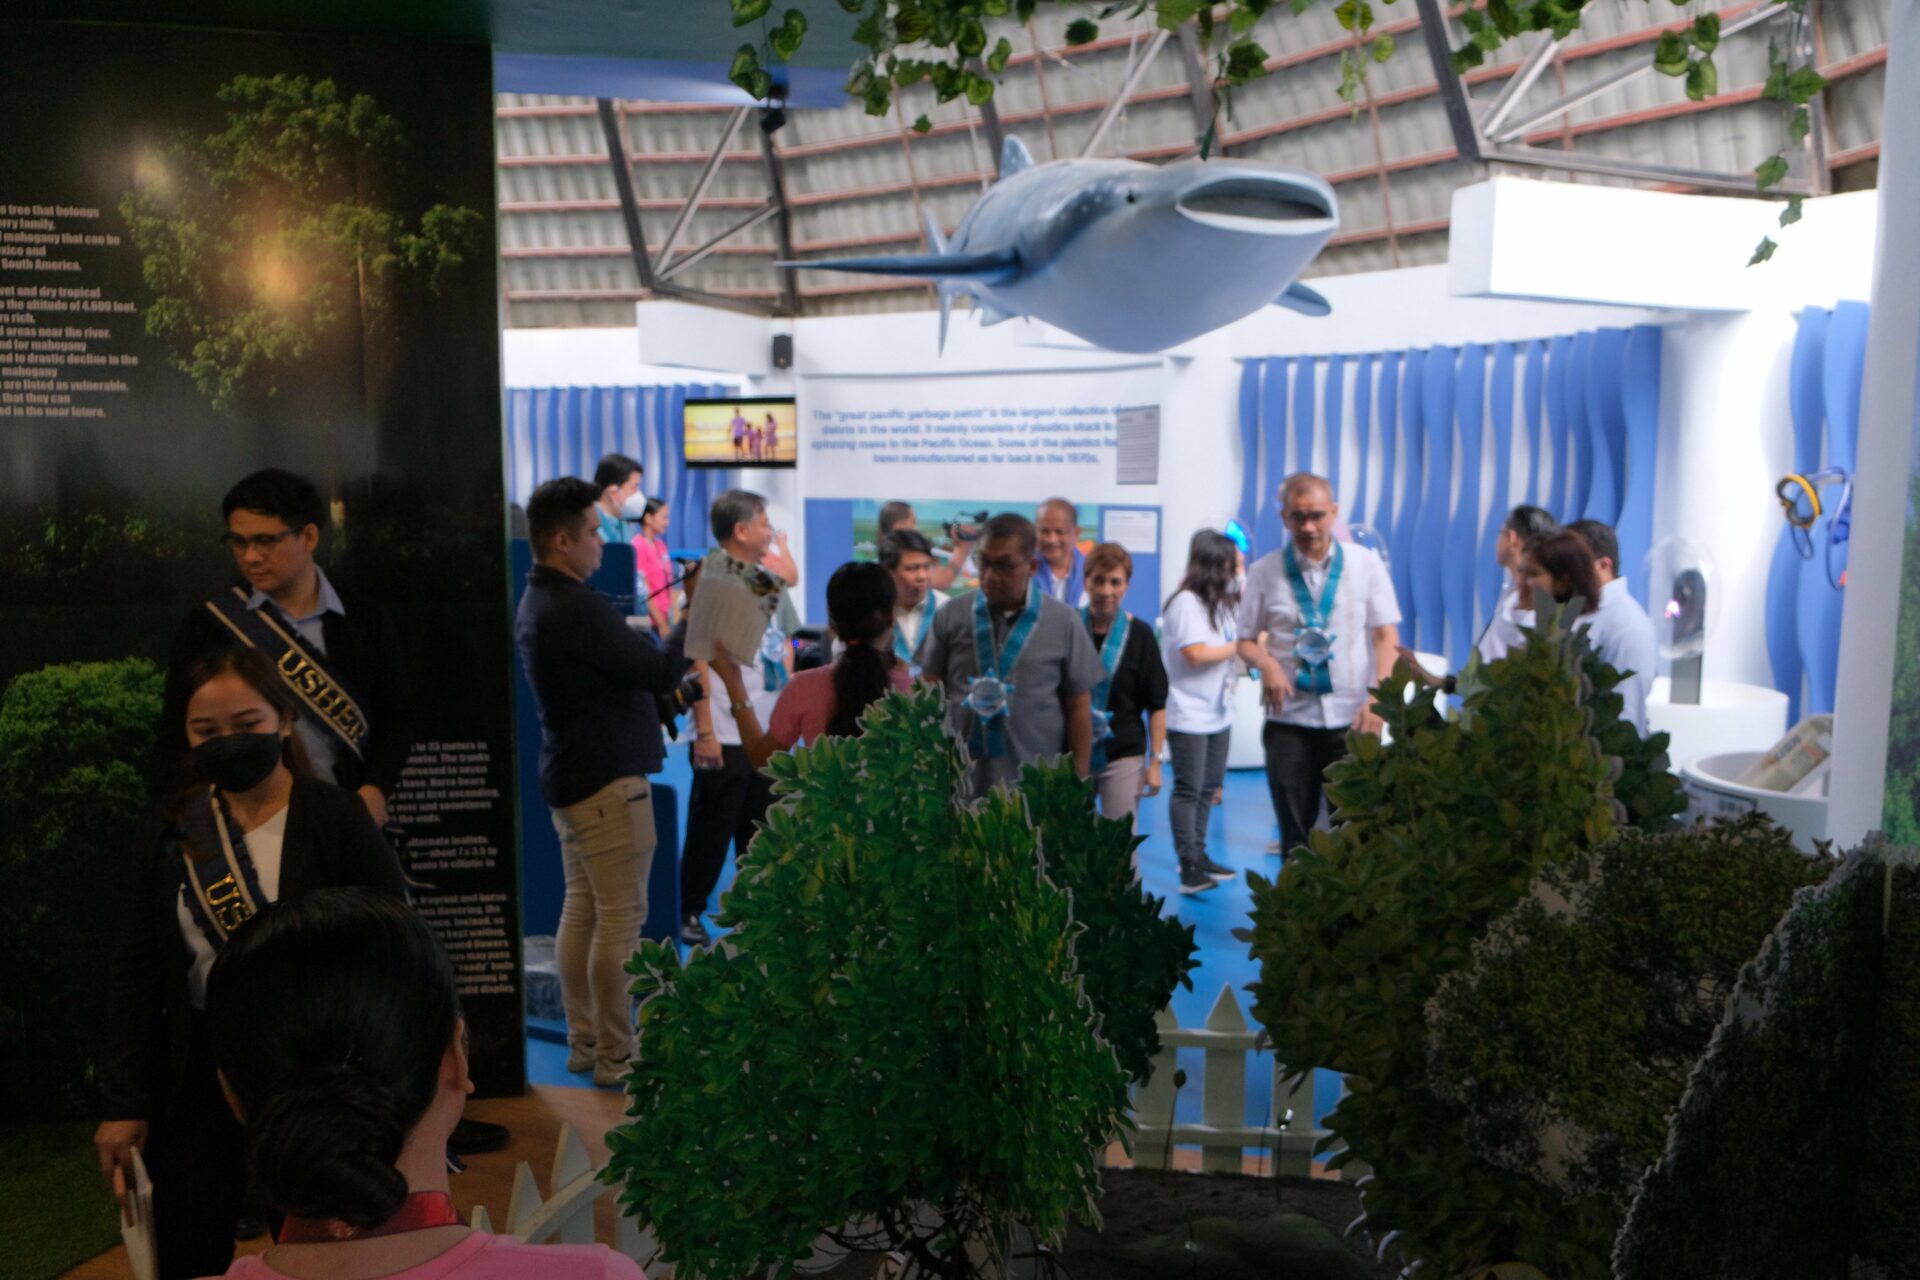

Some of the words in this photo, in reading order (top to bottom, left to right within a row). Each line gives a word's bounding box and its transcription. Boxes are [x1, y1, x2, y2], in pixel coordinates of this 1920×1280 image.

[8, 205, 31, 215] tree
[33, 205, 54, 216] that
[56, 205, 99, 218] belongs
[19, 219, 56, 230] family.
[4, 231, 60, 244] mahogany
[62, 234, 83, 244] that
[85, 236, 104, 245] can
[107, 234, 120, 245] be
[25, 246, 46, 256] and
[1, 258, 33, 269] South
[35, 259, 82, 271] America.
[17, 286, 37, 296] and
[39, 286, 56, 298] dry
[59, 287, 101, 299] tropical
[6, 300, 24, 310] the
[26, 300, 67, 311] altitude
[69, 301, 80, 312] of
[113, 303, 137, 314] feet.
[11, 313, 35, 324] rich.
[7, 327, 36, 336] areas
[39, 328, 62, 337] near
[65, 327, 82, 337] the
[84, 328, 110, 338] river.
[14, 340, 28, 349] for
[31, 341, 87, 352] mahogany
[15, 354, 25, 363] to
[28, 354, 65, 363] drastic
[67, 354, 107, 364] decline
[109, 355, 119, 365] in
[121, 354, 138, 365] the
[2, 367, 57, 378] mahogany
[4, 381, 21, 390] are
[23, 380, 53, 390] listed
[56, 381, 68, 390] as
[70, 380, 128, 392] vulnerable.
[2, 393, 23, 403] that
[25, 393, 49, 405] they
[51, 395, 70, 403] can
[13, 407, 24, 416] in
[26, 407, 43, 416] the
[45, 408, 69, 417] near
[71, 406, 106, 417] future.
[813, 410, 832, 419] The
[869, 409, 903, 420] pacific
[909, 410, 950, 420] garbage
[989, 408, 997, 416] is
[1001, 407, 1018, 417] the
[1022, 407, 1056, 418] largest
[822, 425, 854, 434] debris
[858, 425, 866, 433] in
[870, 425, 886, 434] the
[1017, 422, 1028, 432] of
[1031, 422, 1070, 433] plastics
[922, 439, 955, 447] Pacific
[998, 439, 1027, 447] Some
[1030, 438, 1041, 447] of
[1043, 438, 1058, 447] the
[873, 454, 898, 462] been
[1008, 453, 1032, 463] back
[1036, 454, 1044, 463] in
[1048, 453, 1064, 463] the
